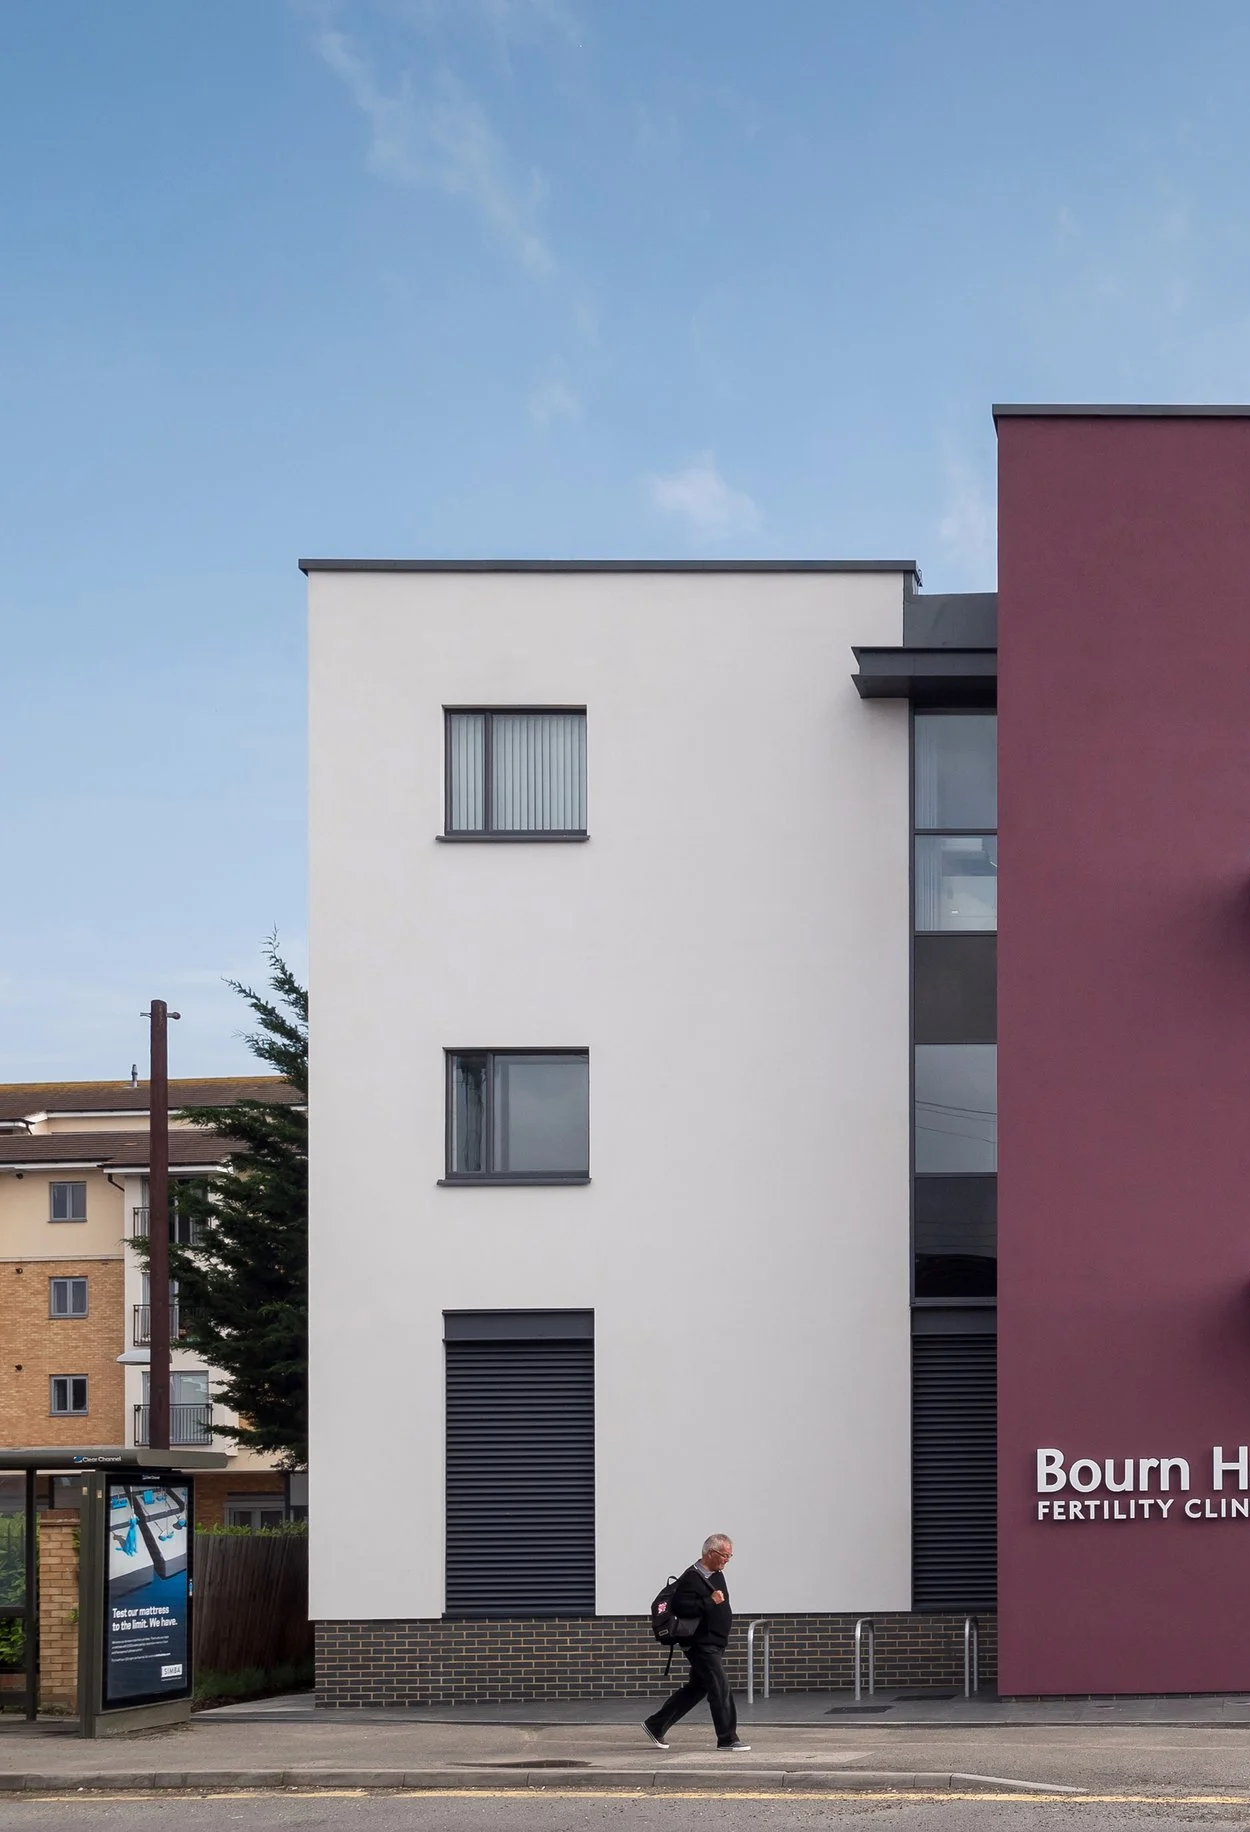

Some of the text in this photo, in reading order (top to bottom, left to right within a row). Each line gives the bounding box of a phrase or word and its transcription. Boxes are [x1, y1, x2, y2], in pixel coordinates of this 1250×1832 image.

[1036, 1448, 1190, 1493] Bourn
[1037, 1499, 1175, 1521] FERTILITY
[112, 1606, 170, 1619] Test our mattress
[112, 1617, 178, 1631] to the limit. We have.
[163, 1666, 181, 1675] SIMBA
